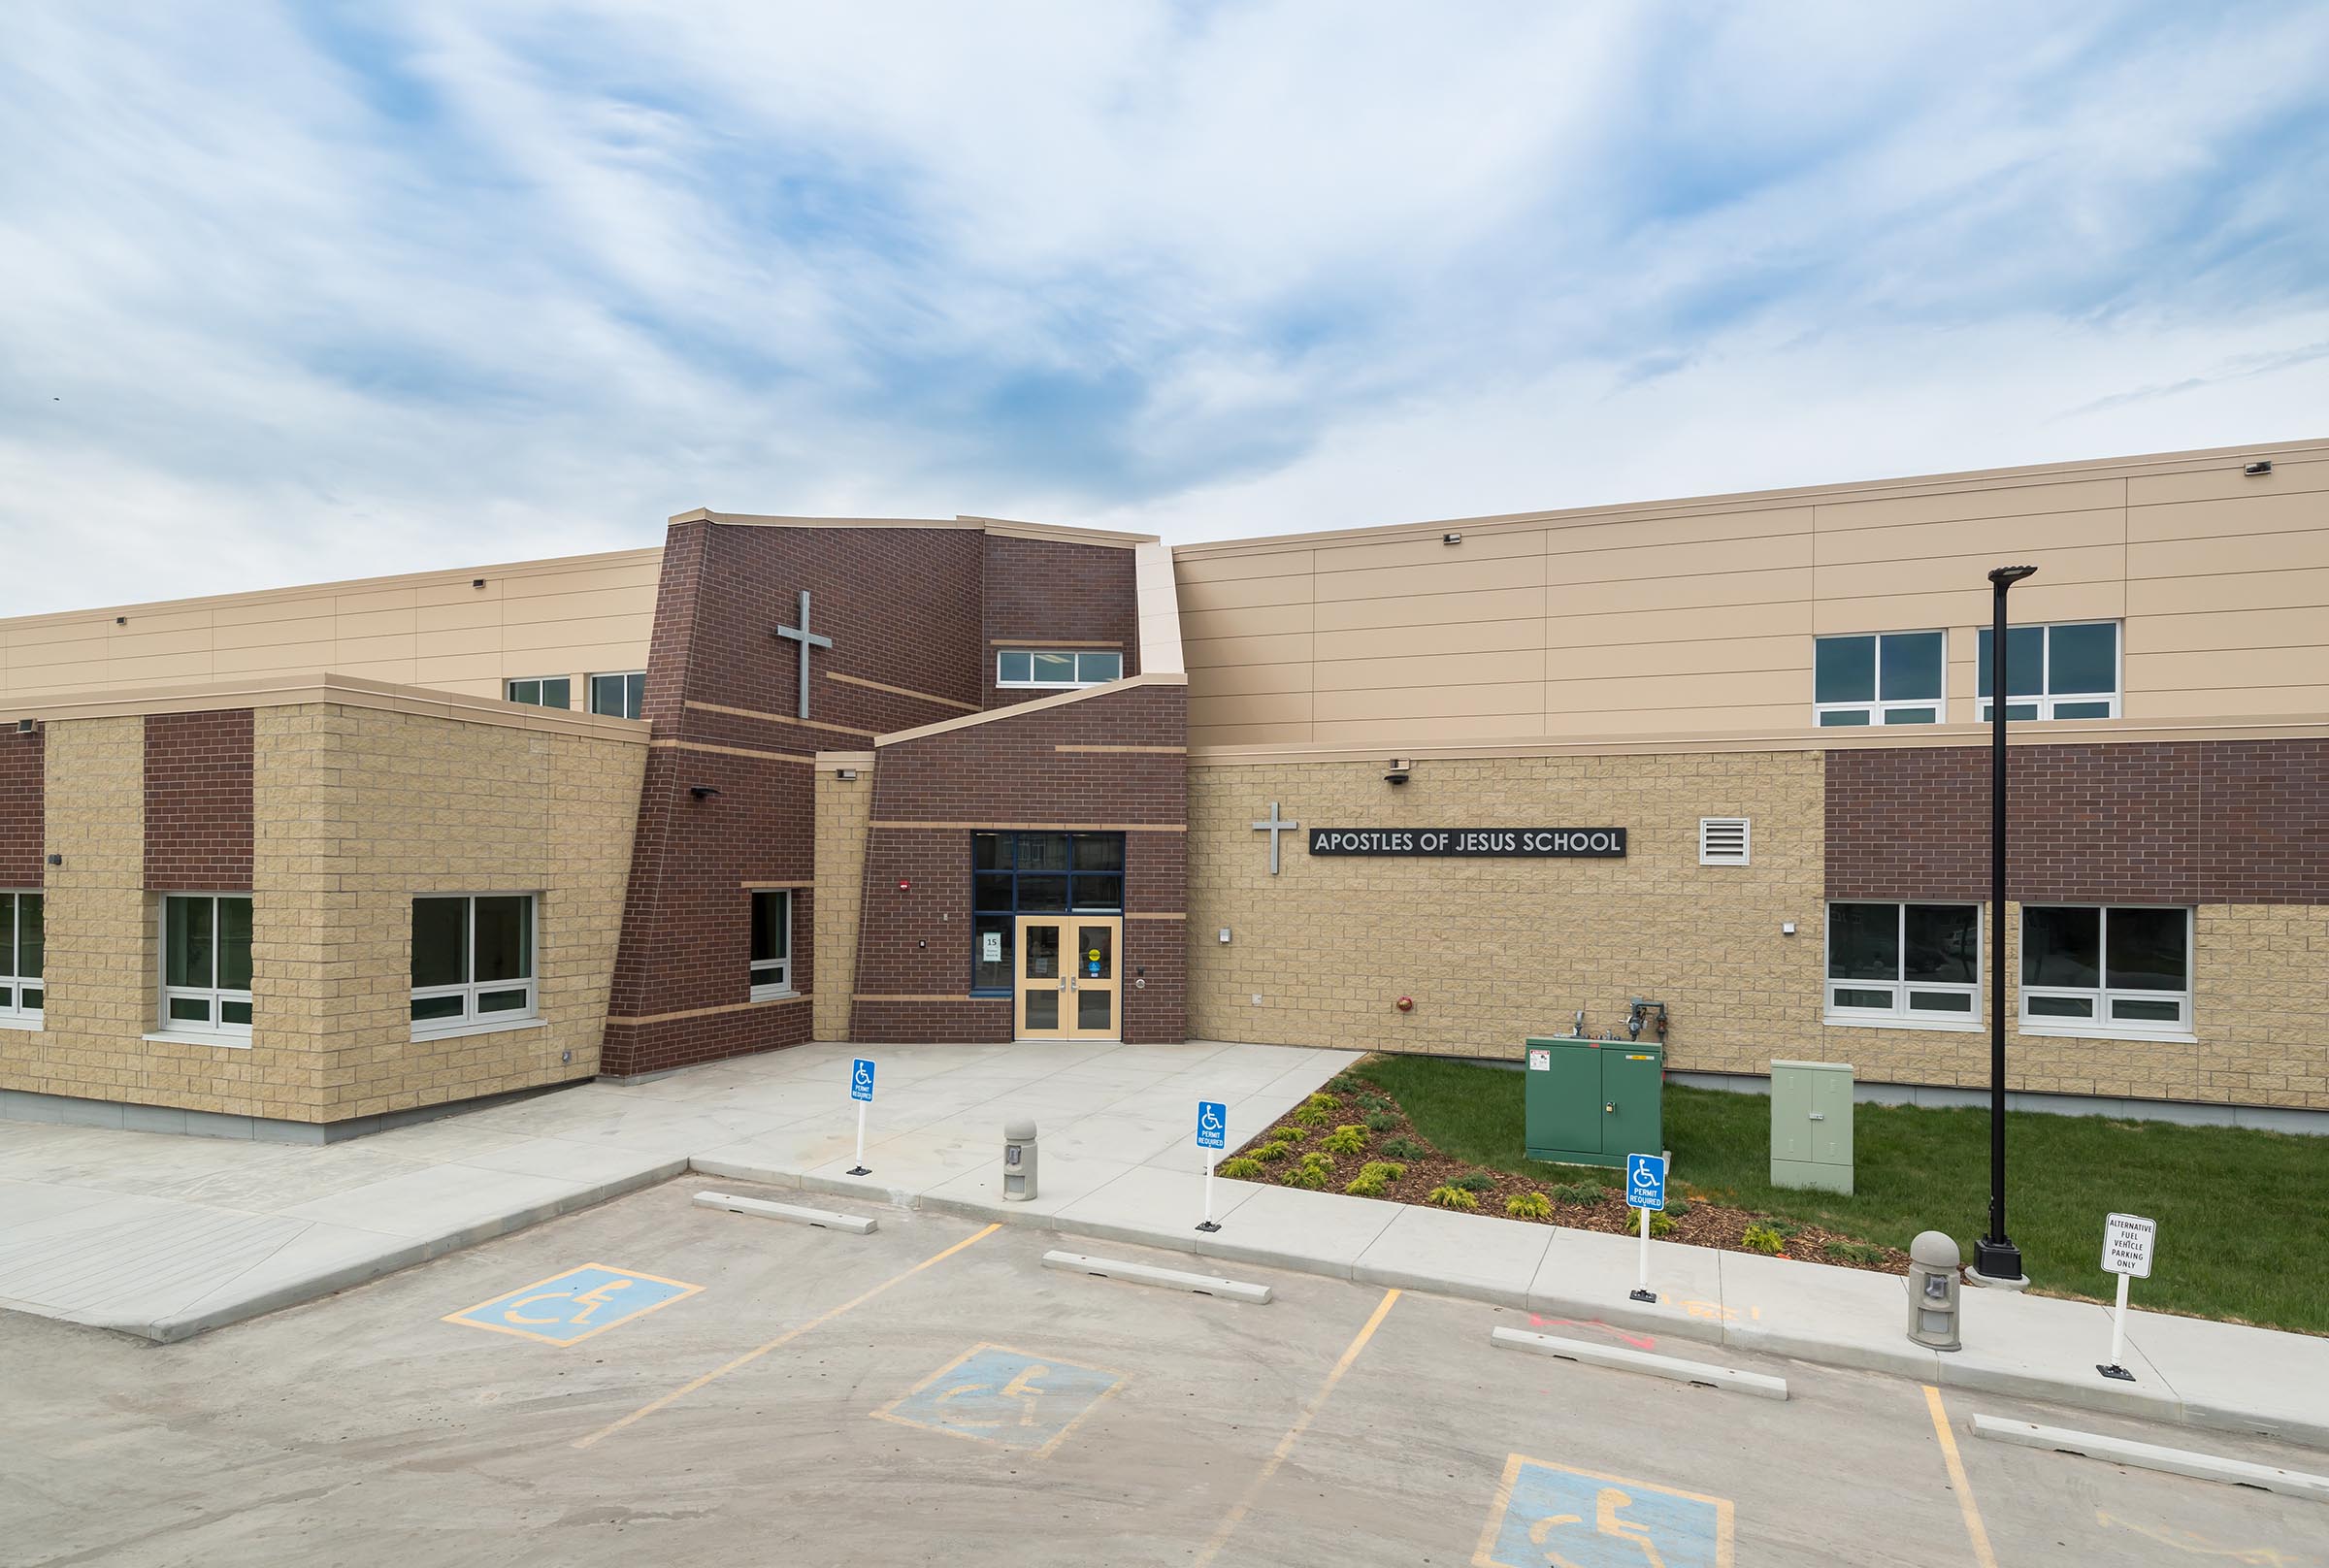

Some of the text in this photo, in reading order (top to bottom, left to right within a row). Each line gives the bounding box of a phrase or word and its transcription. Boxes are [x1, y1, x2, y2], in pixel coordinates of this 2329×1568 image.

[1314, 833, 1621, 852] APOSTLES OF JESUS SCHOOL
[1198, 1137, 1224, 1146] REQUIRED
[1633, 1188, 1657, 1197] PERMIT
[1629, 1194, 1661, 1206] REQUIRED
[2110, 1219, 2152, 1233] ALTERNATIVE
[2120, 1230, 2138, 1241] FUEL
[2114, 1239, 2144, 1252] VEHICLE
[2111, 1248, 2144, 1261] PARKING
[2116, 1258, 2136, 1269] ONLY
